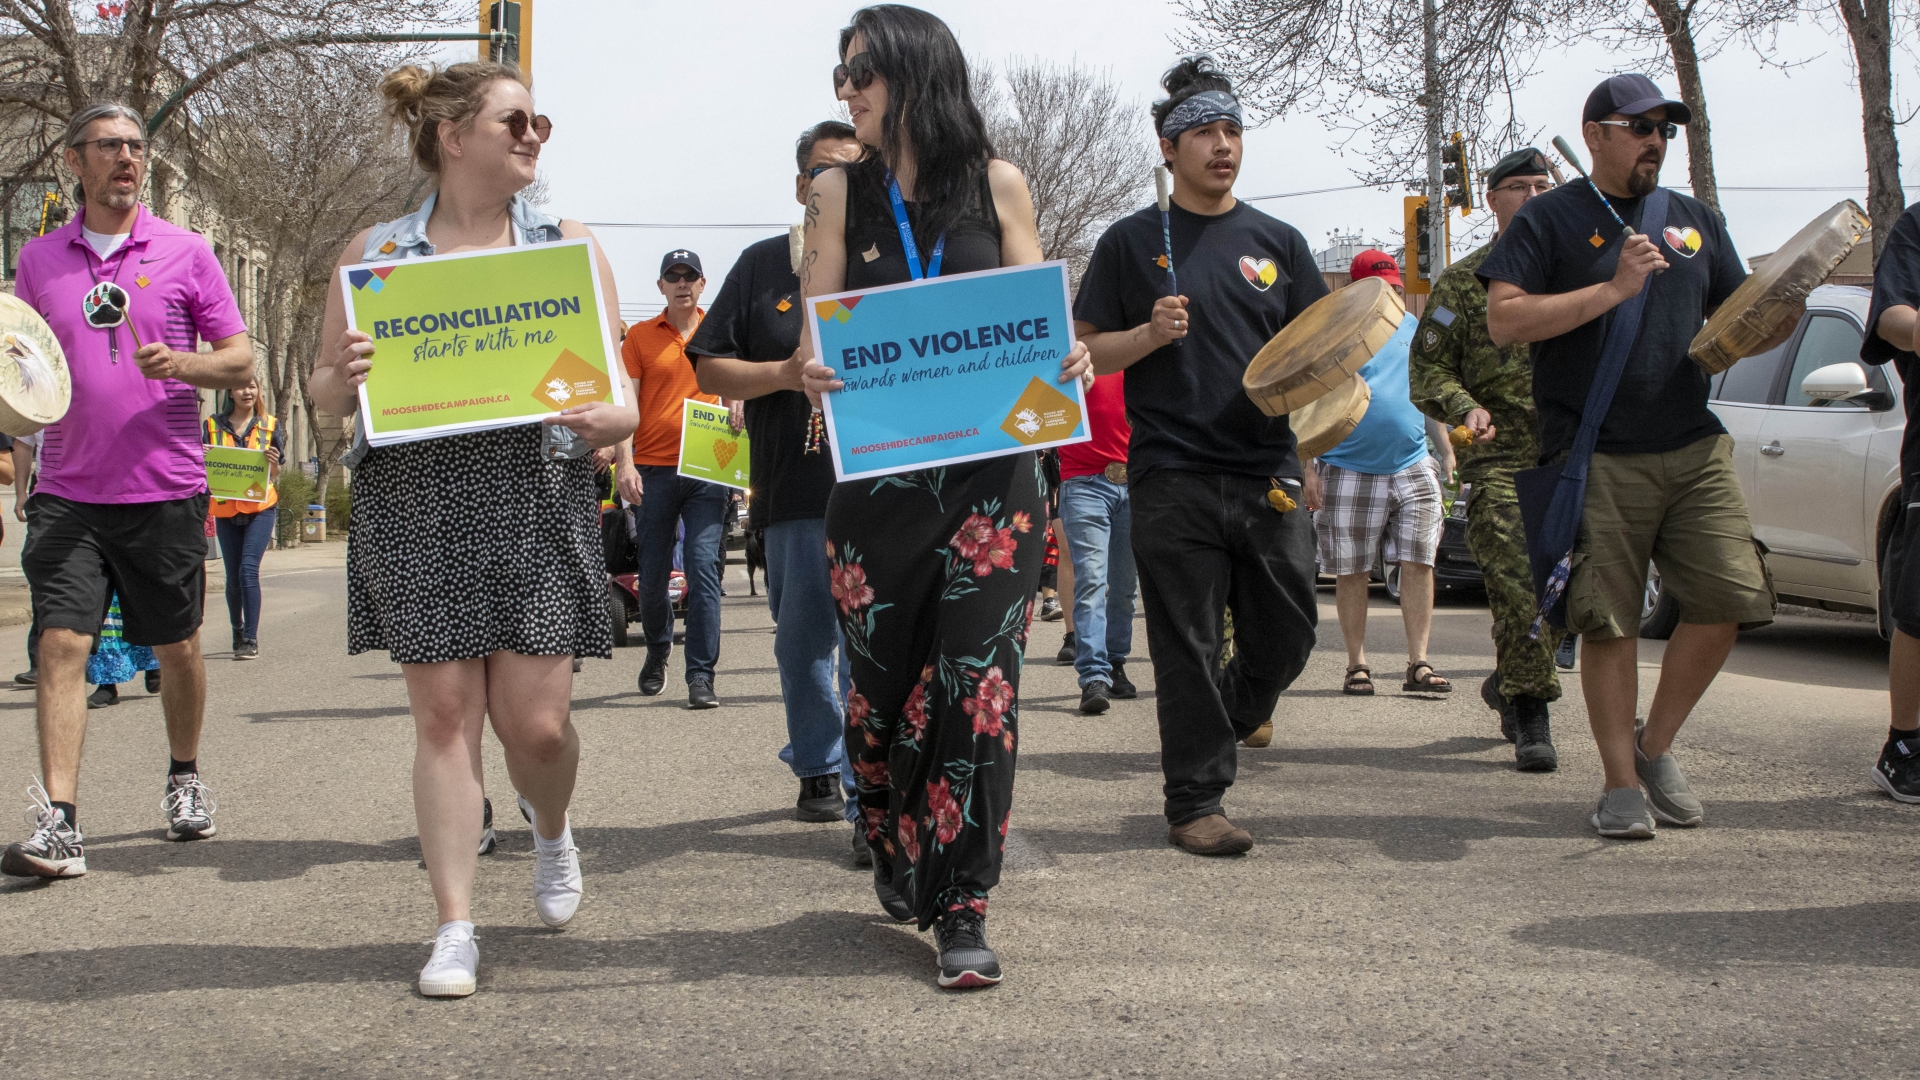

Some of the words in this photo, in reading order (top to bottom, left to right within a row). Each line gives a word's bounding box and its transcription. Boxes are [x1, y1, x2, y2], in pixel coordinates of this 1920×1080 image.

[374, 296, 581, 340] RECONCILIATION
[413, 335, 471, 363] starts
[475, 326, 518, 352] with
[524, 329, 557, 346] me
[841, 341, 902, 370] END
[908, 317, 1050, 358] VIOLENCE
[840, 367, 897, 394] towards
[902, 363, 953, 383] women
[958, 352, 991, 375] and
[995, 345, 1060, 369] children
[382, 395, 511, 417] MOOSEHIDECAMPAIGN.CA
[692, 409, 715, 422] END
[851, 427, 980, 455] MOOSEHIDECAMPAIGN.CA
[204, 461, 265, 472] RECONCILIATION
